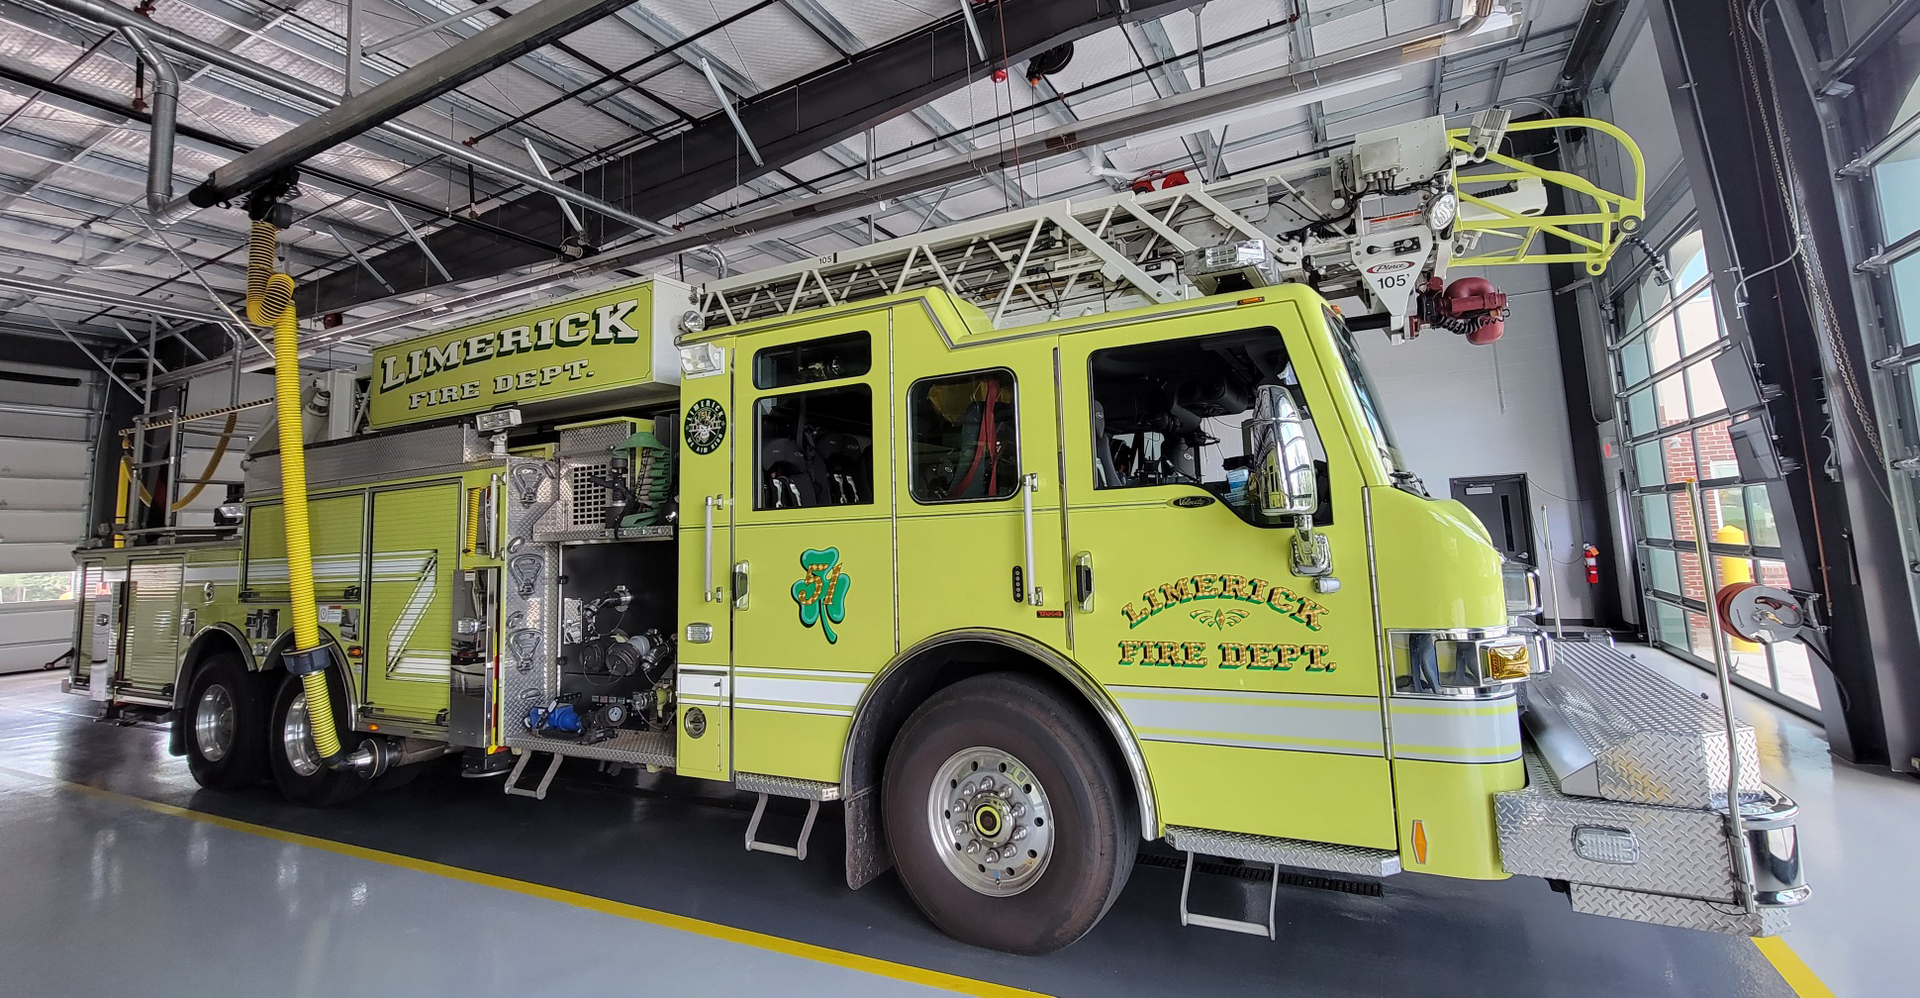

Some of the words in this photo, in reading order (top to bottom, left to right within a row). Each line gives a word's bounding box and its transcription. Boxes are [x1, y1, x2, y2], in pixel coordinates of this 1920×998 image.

[819, 255, 832, 264] 105
[1376, 263, 1404, 272] Pierce
[380, 299, 639, 393] LIMERICK
[409, 380, 480, 410] FIRE
[493, 359, 596, 395] DEPT.
[687, 400, 724, 421] LIMERICK
[1179, 497, 1205, 507] Velocity
[798, 561, 843, 605] 51
[1121, 573, 1330, 632] LIMERICK
[1118, 640, 1208, 668] FIRE
[1218, 642, 1337, 673] DEPT.
